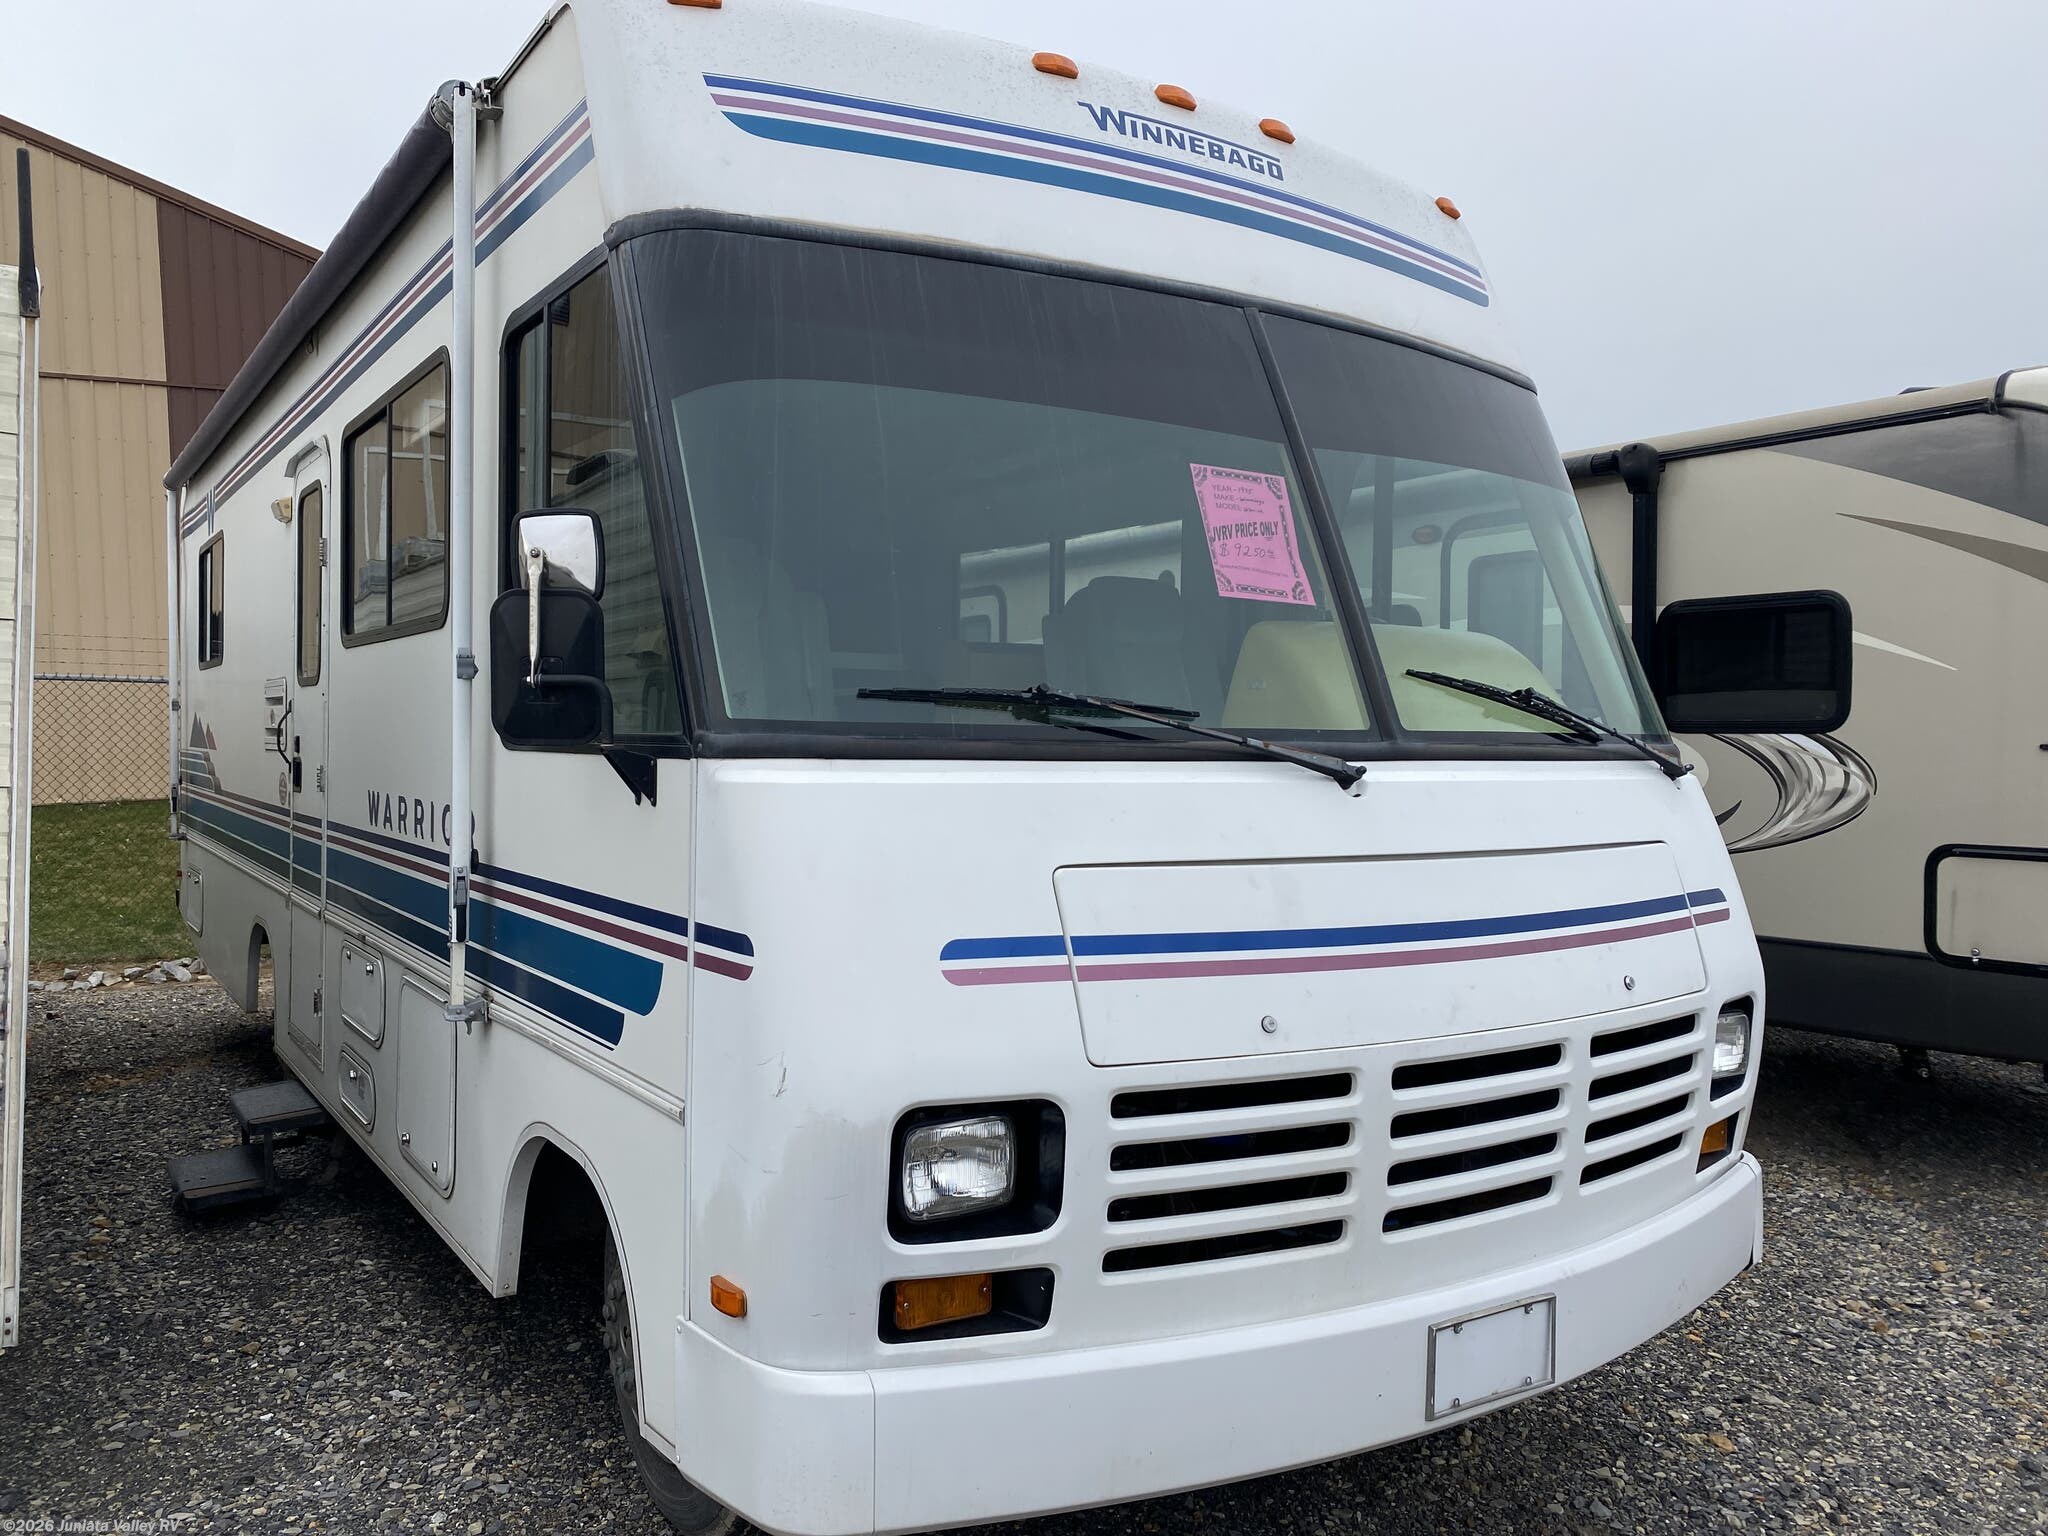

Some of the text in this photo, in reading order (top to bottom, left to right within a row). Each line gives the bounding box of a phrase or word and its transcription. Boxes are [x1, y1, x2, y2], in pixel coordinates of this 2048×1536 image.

[1077, 101, 1284, 181] WINNEBAGO
[1212, 521, 1279, 542] JVRV PRICE ONLY
